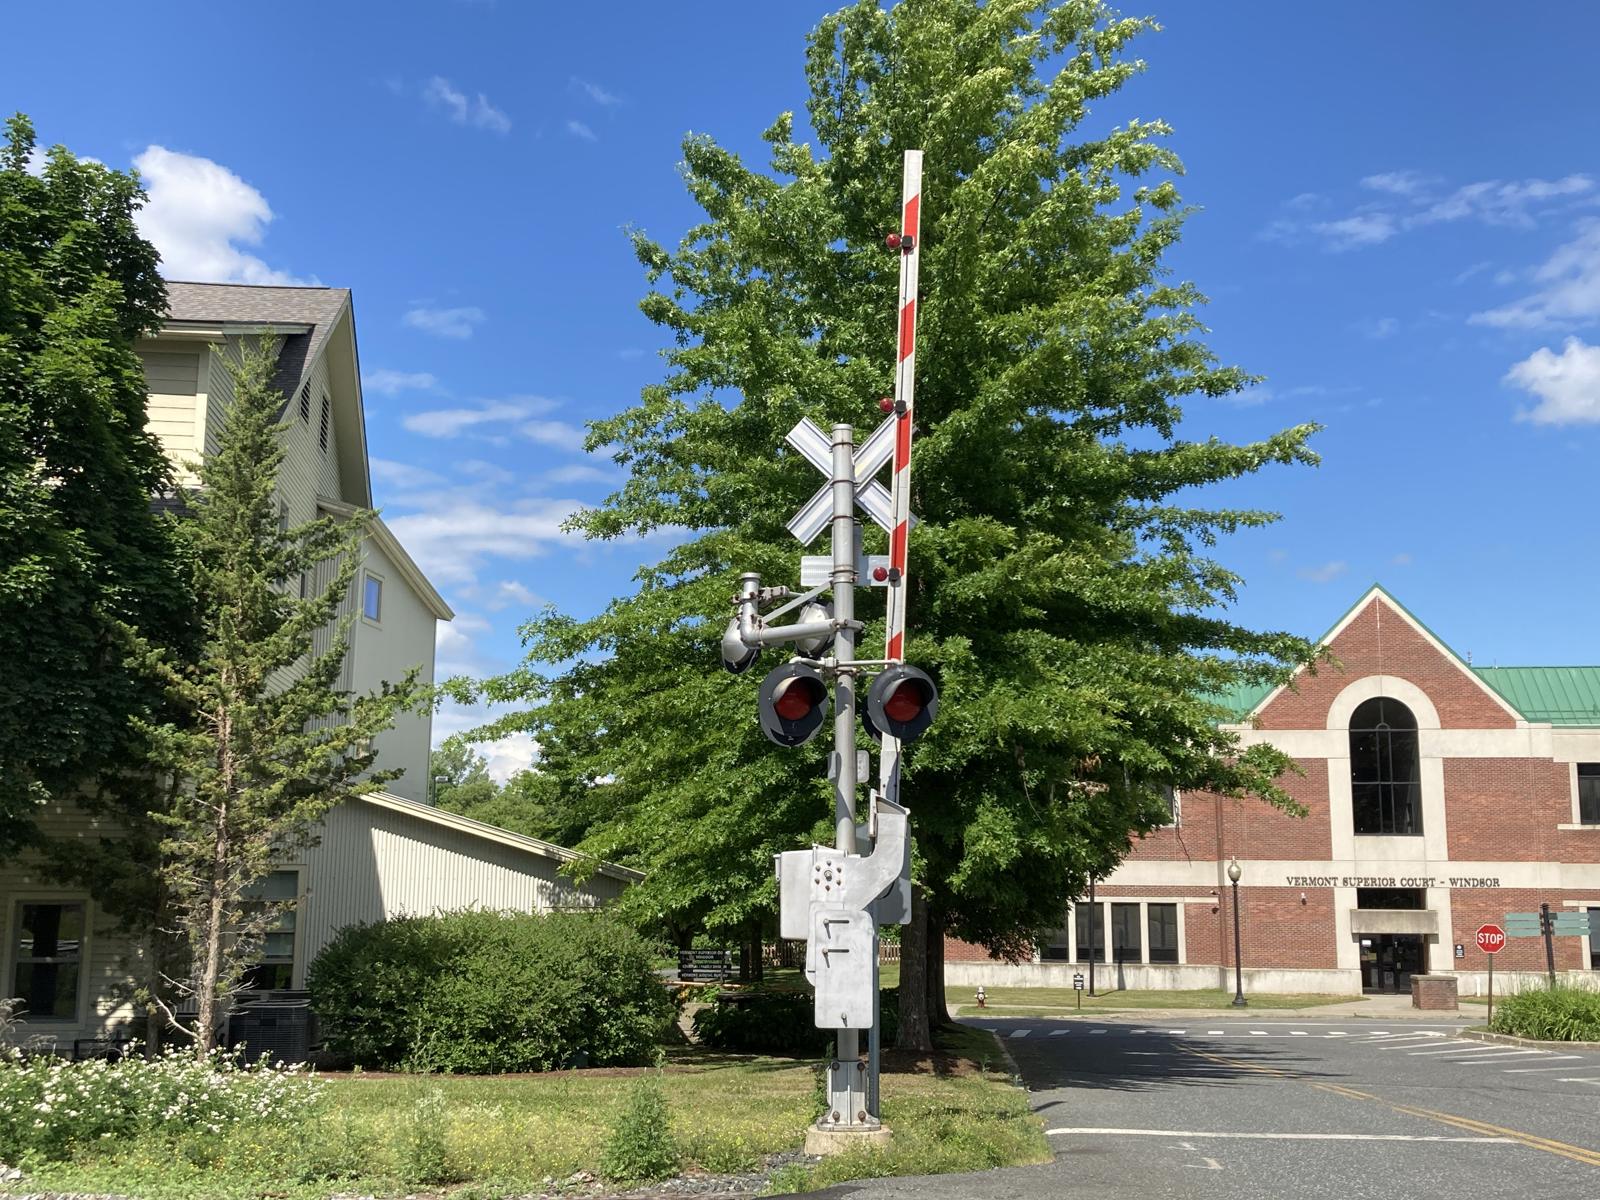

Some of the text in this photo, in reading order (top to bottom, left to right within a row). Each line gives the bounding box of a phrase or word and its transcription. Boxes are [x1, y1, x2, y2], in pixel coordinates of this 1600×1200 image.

[1286, 876, 1338, 887] VERMONT
[1342, 876, 1396, 887] SUPERIOR
[1400, 877, 1436, 887] COURT
[1449, 877, 1501, 888] WINDSOR
[1478, 932, 1504, 945] STOP
